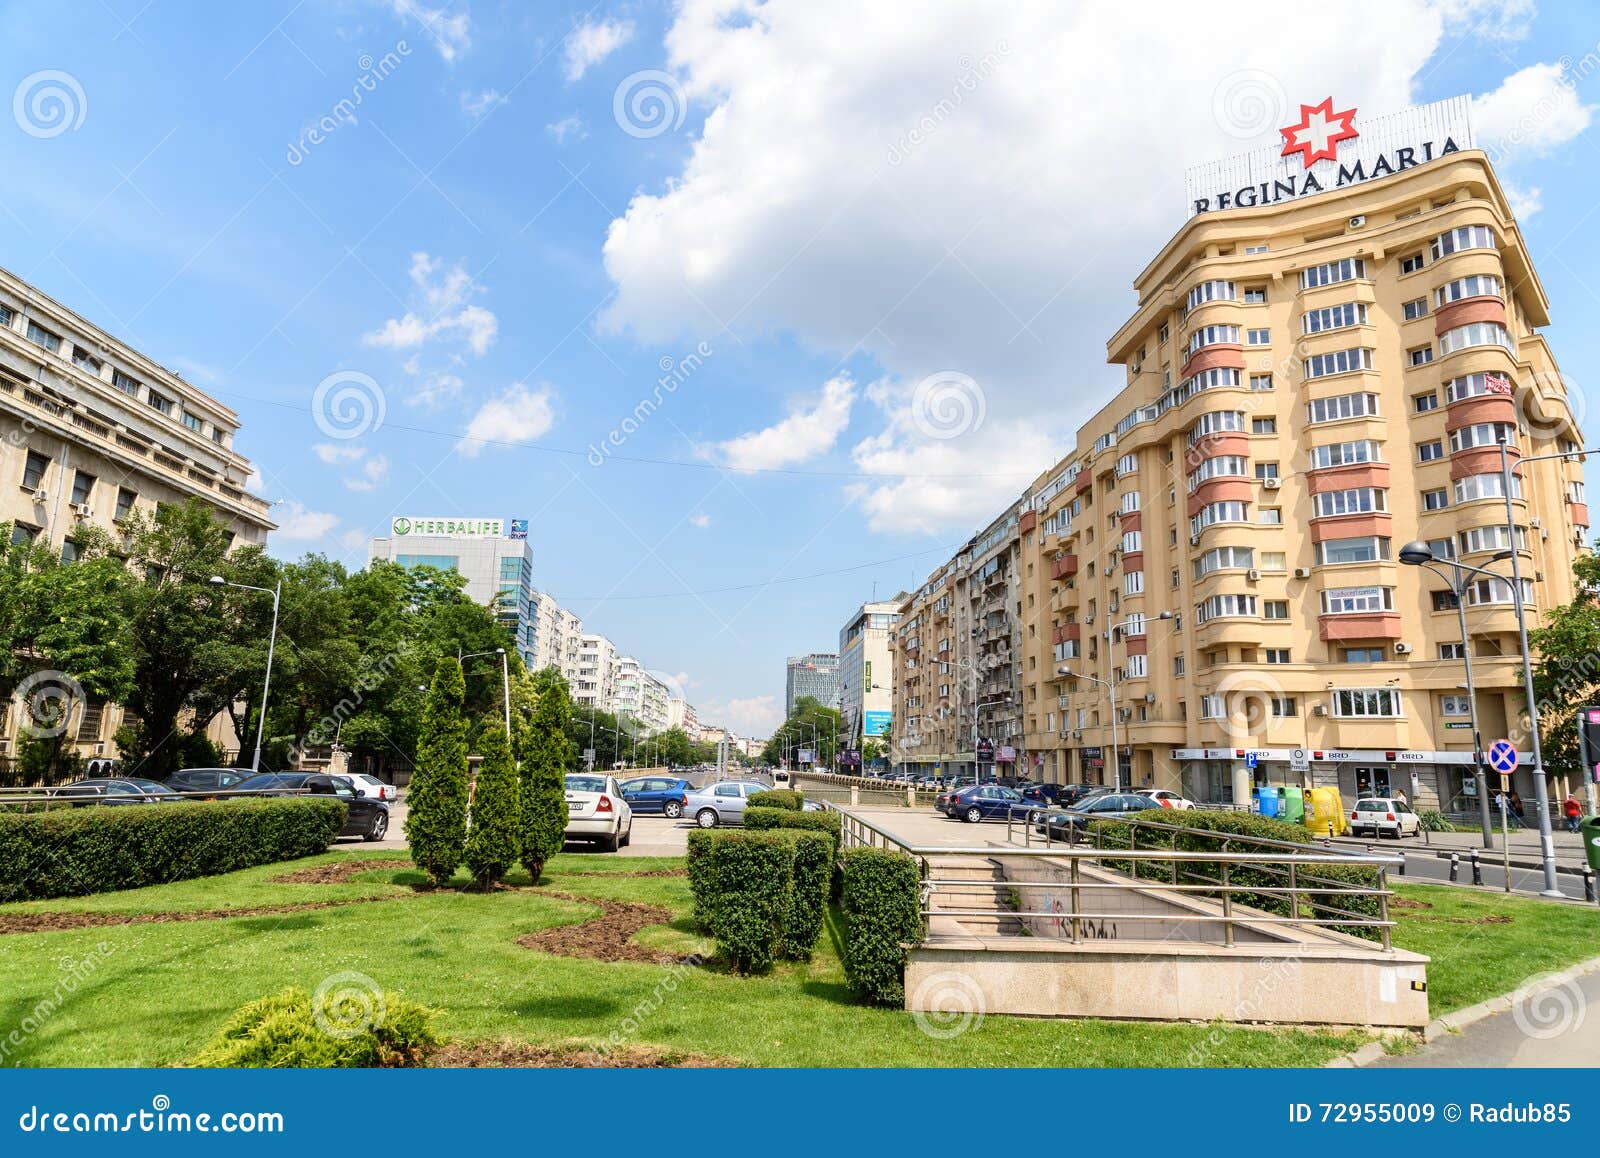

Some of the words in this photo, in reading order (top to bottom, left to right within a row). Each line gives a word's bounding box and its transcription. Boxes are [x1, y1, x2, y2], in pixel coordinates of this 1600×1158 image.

[1194, 171, 1324, 214] REGINA
[1336, 137, 1460, 186] MARIA
[414, 521, 500, 535] HERBALIFE
[1248, 754, 1255, 765] P
